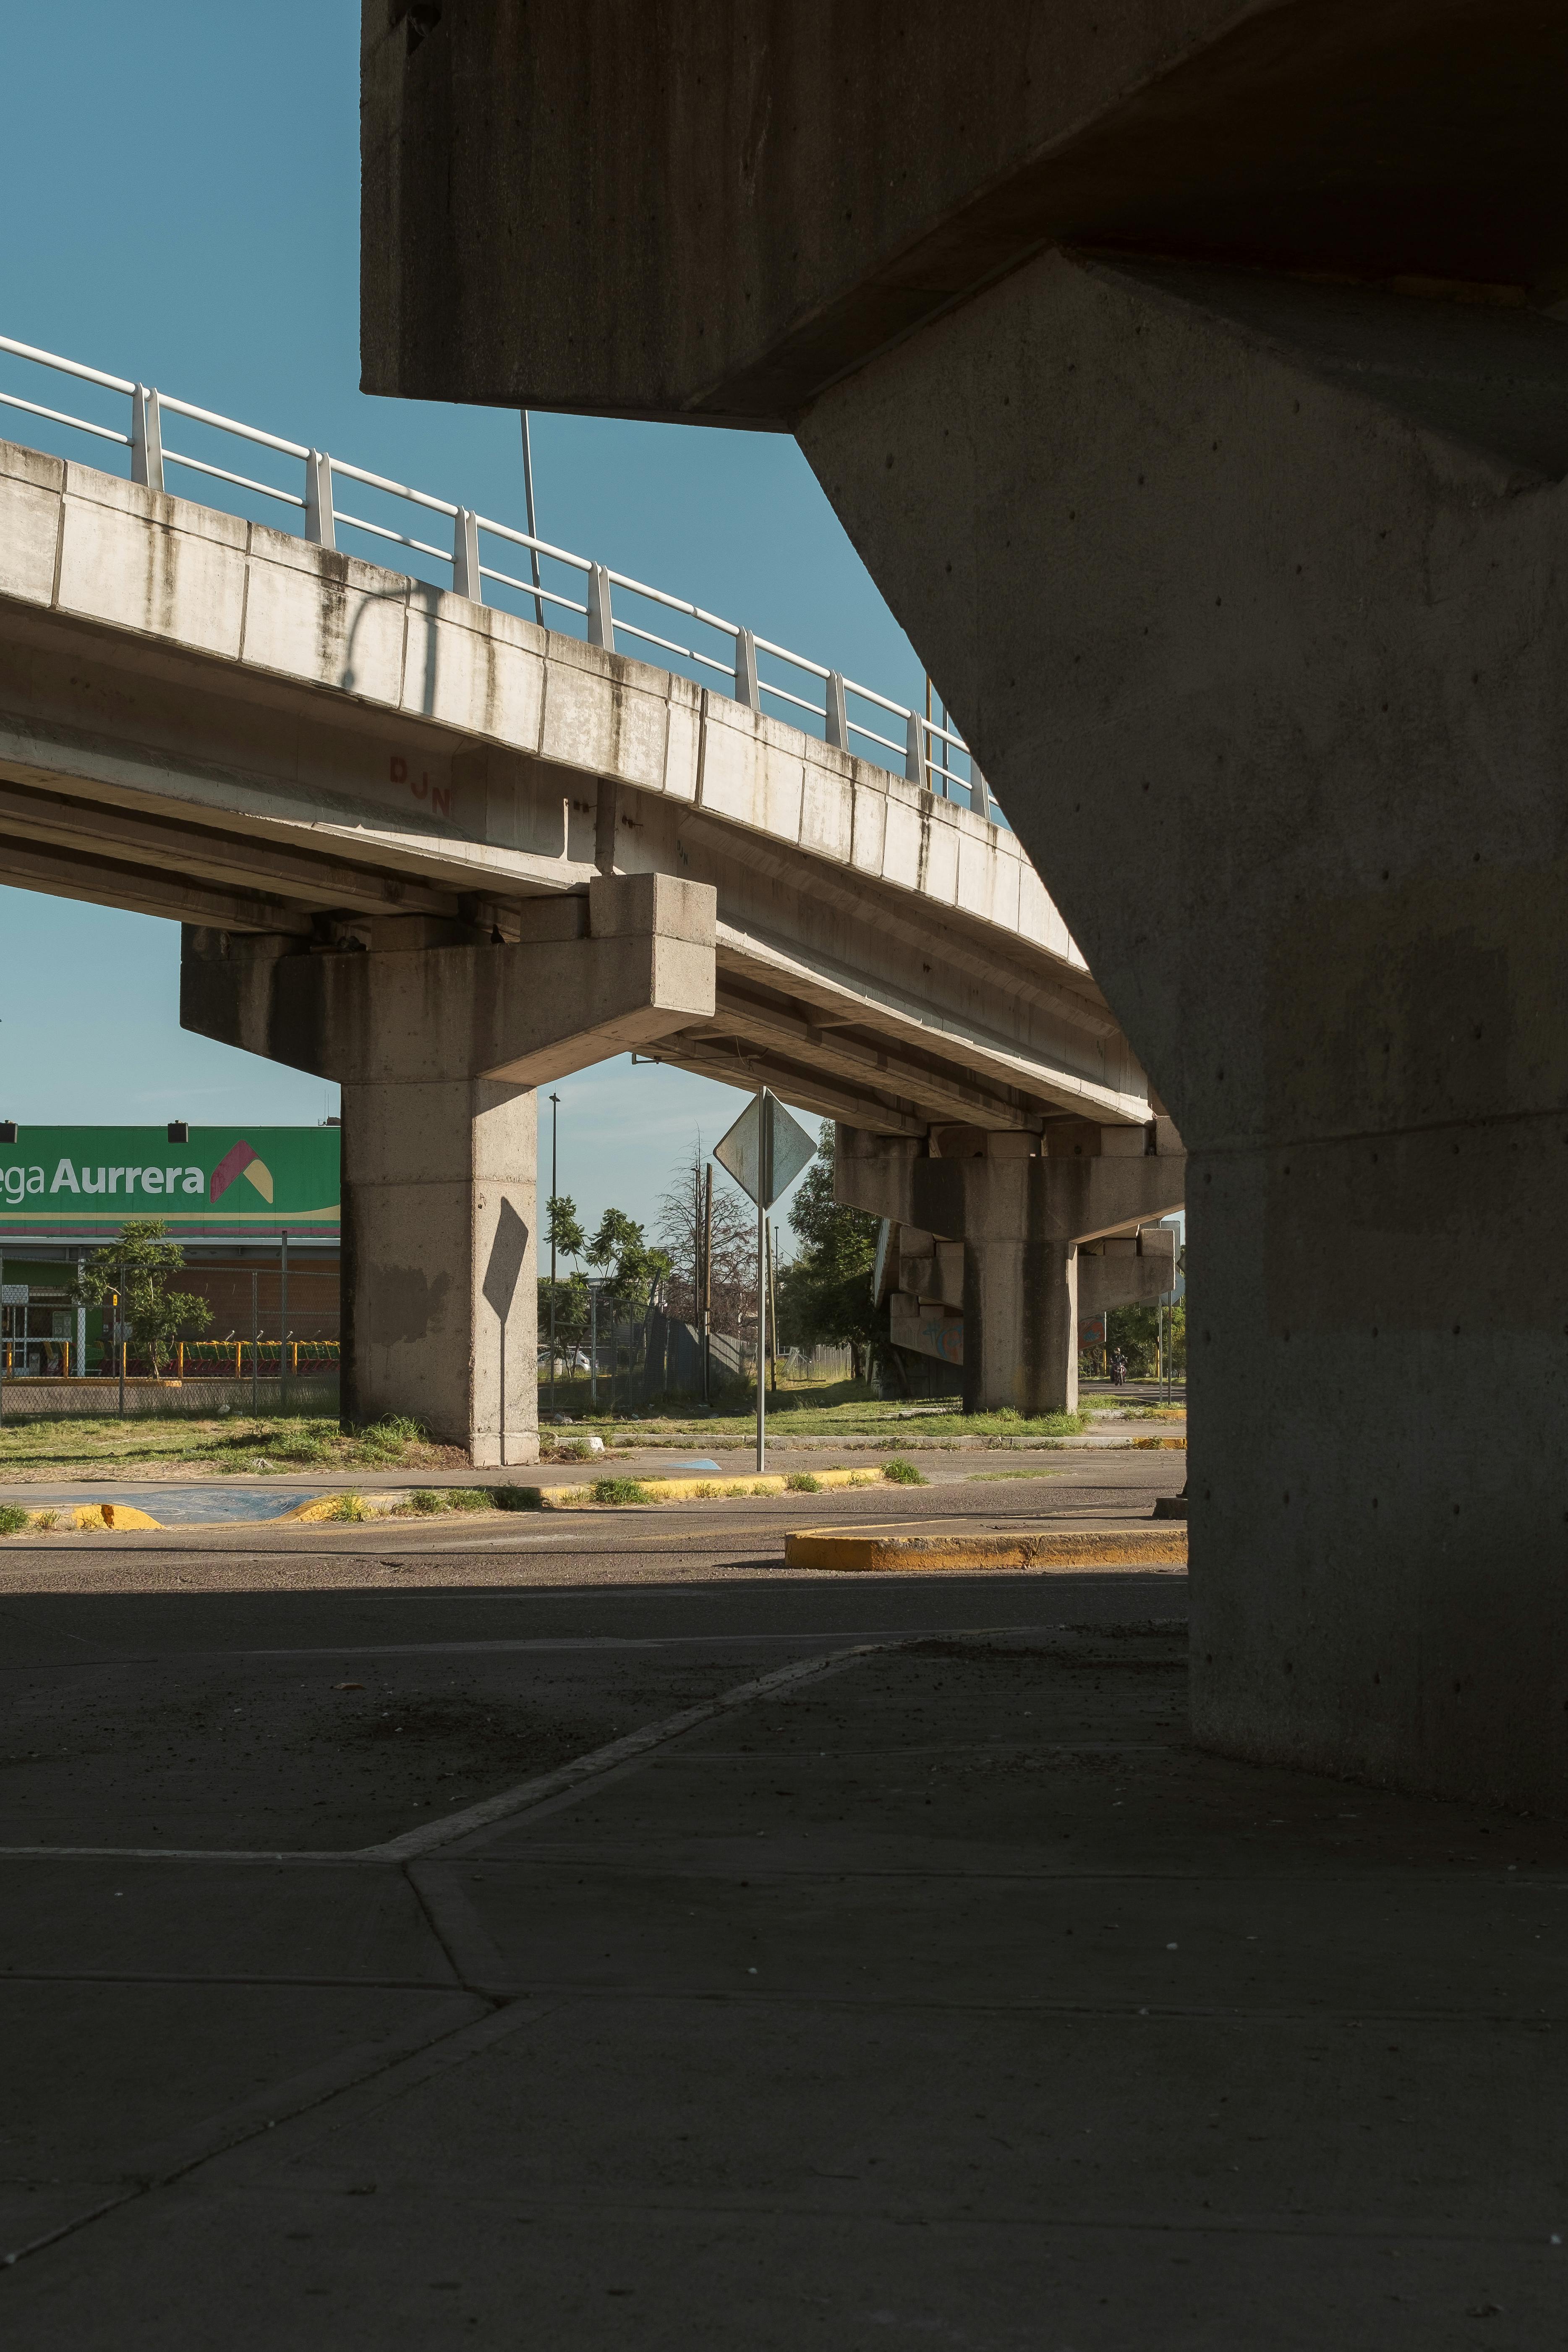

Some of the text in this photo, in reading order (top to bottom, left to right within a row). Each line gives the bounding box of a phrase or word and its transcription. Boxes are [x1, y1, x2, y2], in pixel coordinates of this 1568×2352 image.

[390, 757, 450, 817] DJN
[0, 1158, 204, 1204] ga Aurrera
